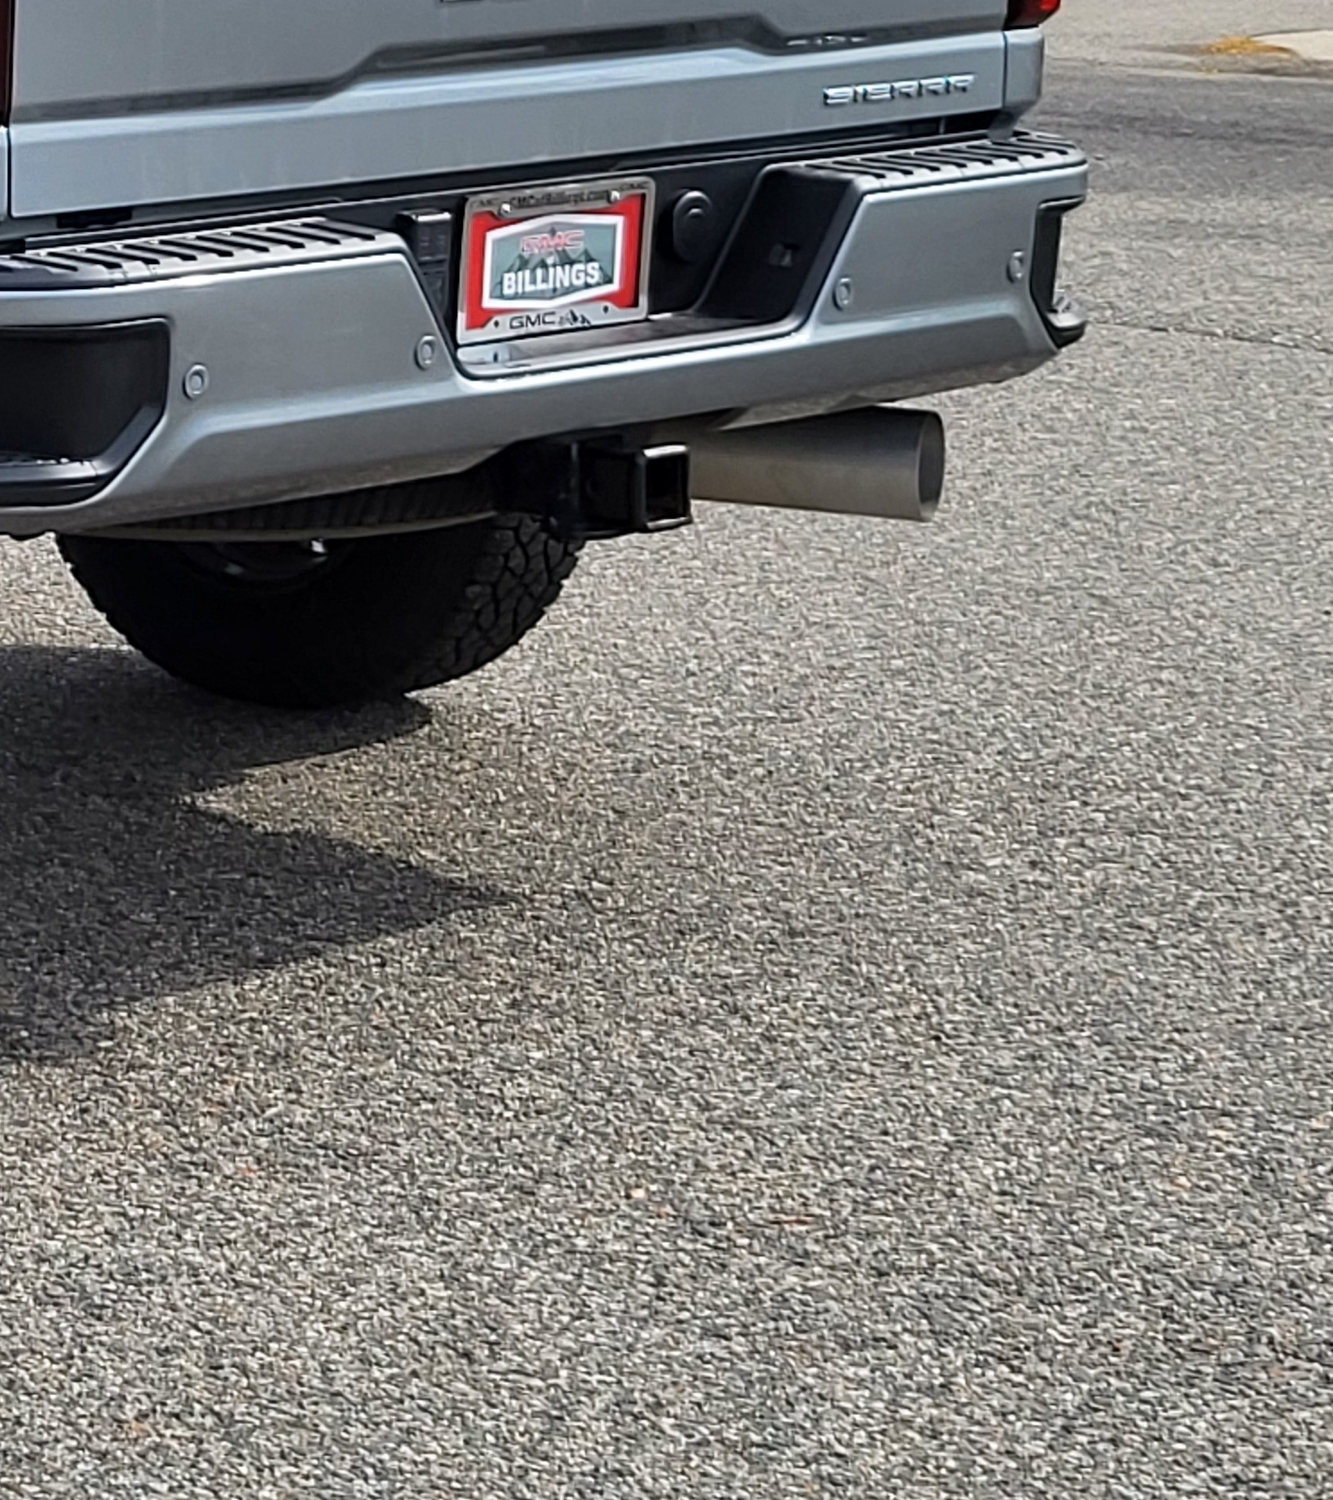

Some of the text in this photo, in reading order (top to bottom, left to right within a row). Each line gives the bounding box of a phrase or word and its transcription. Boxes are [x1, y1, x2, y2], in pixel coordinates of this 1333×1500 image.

[823, 73, 975, 106] SIERRA
[520, 229, 585, 255] GMC
[501, 261, 600, 295] BILLINGS
[509, 311, 557, 330] GMC
